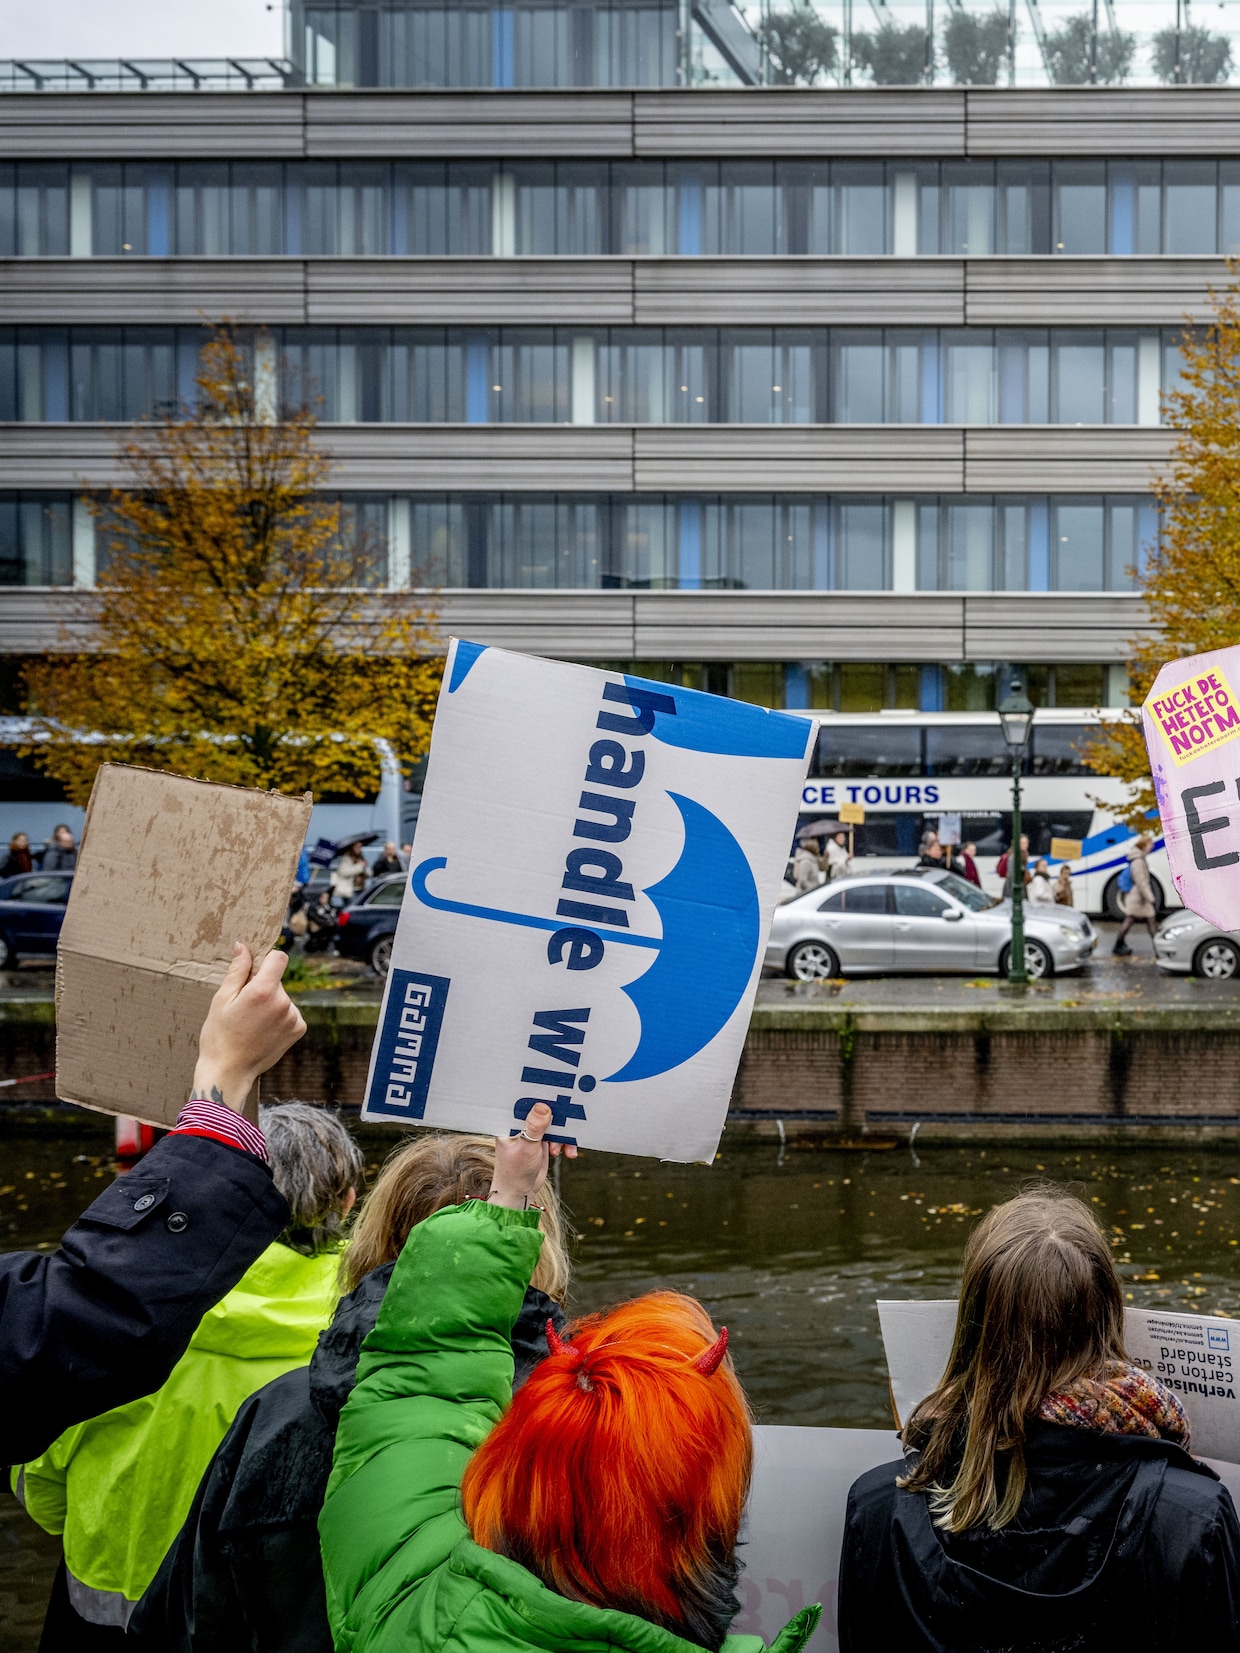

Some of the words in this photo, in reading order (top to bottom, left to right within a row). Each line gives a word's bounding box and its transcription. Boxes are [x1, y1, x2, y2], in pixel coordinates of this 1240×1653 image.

[1152, 685, 1197, 719] FUCK
[1196, 673, 1222, 696] DE
[846, 785, 939, 805] TOURS
[547, 681, 677, 972] handle
[1147, 1327, 1204, 1339] gamma.be/verhuizen
[1149, 1334, 1205, 1346] gamma.nl/verhuizen
[1160, 1347, 1232, 1368] standard
[1157, 1362, 1176, 1376] de
[1181, 1365, 1234, 1383] carton
